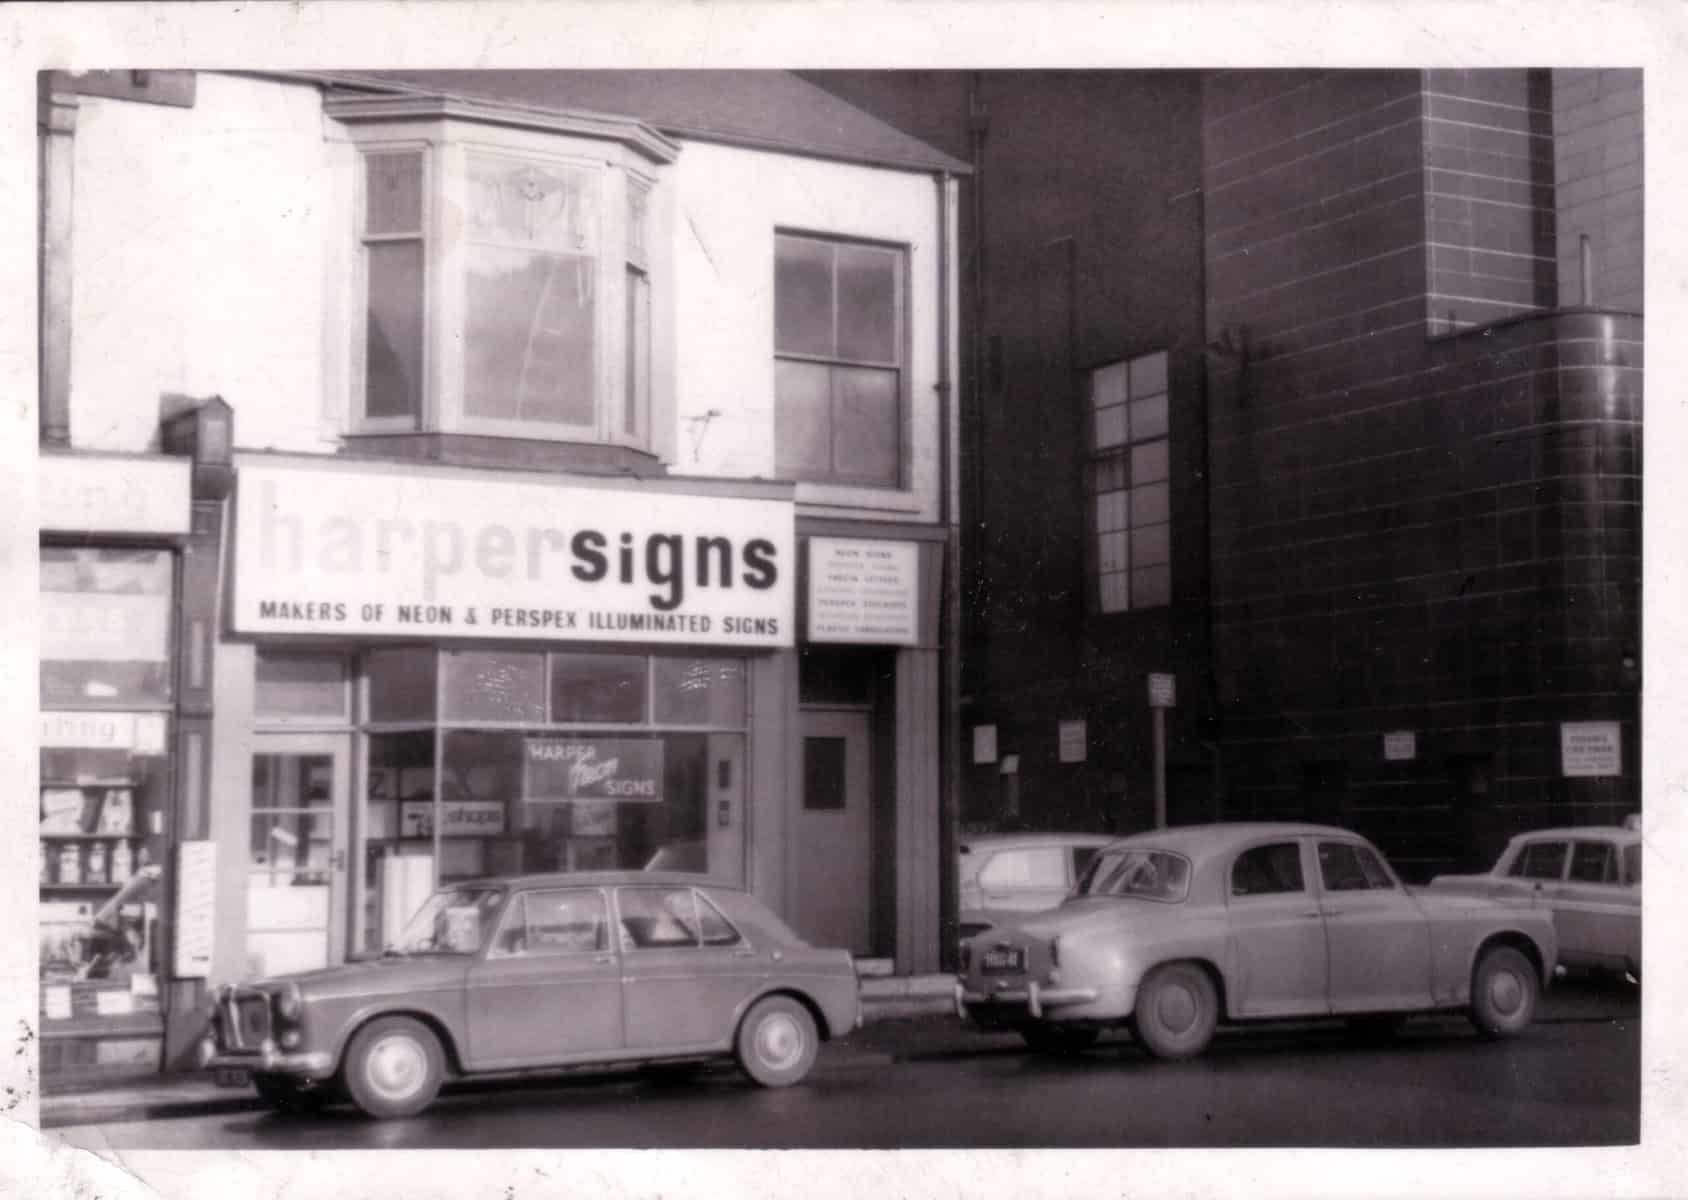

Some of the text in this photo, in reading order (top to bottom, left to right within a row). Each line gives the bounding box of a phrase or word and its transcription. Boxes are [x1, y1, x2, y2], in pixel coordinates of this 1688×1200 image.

[259, 601, 780, 636] MAKERS OF NEON & PERSPEX ILLUMINATED SIGNS
[605, 779, 656, 796] SIGNS
